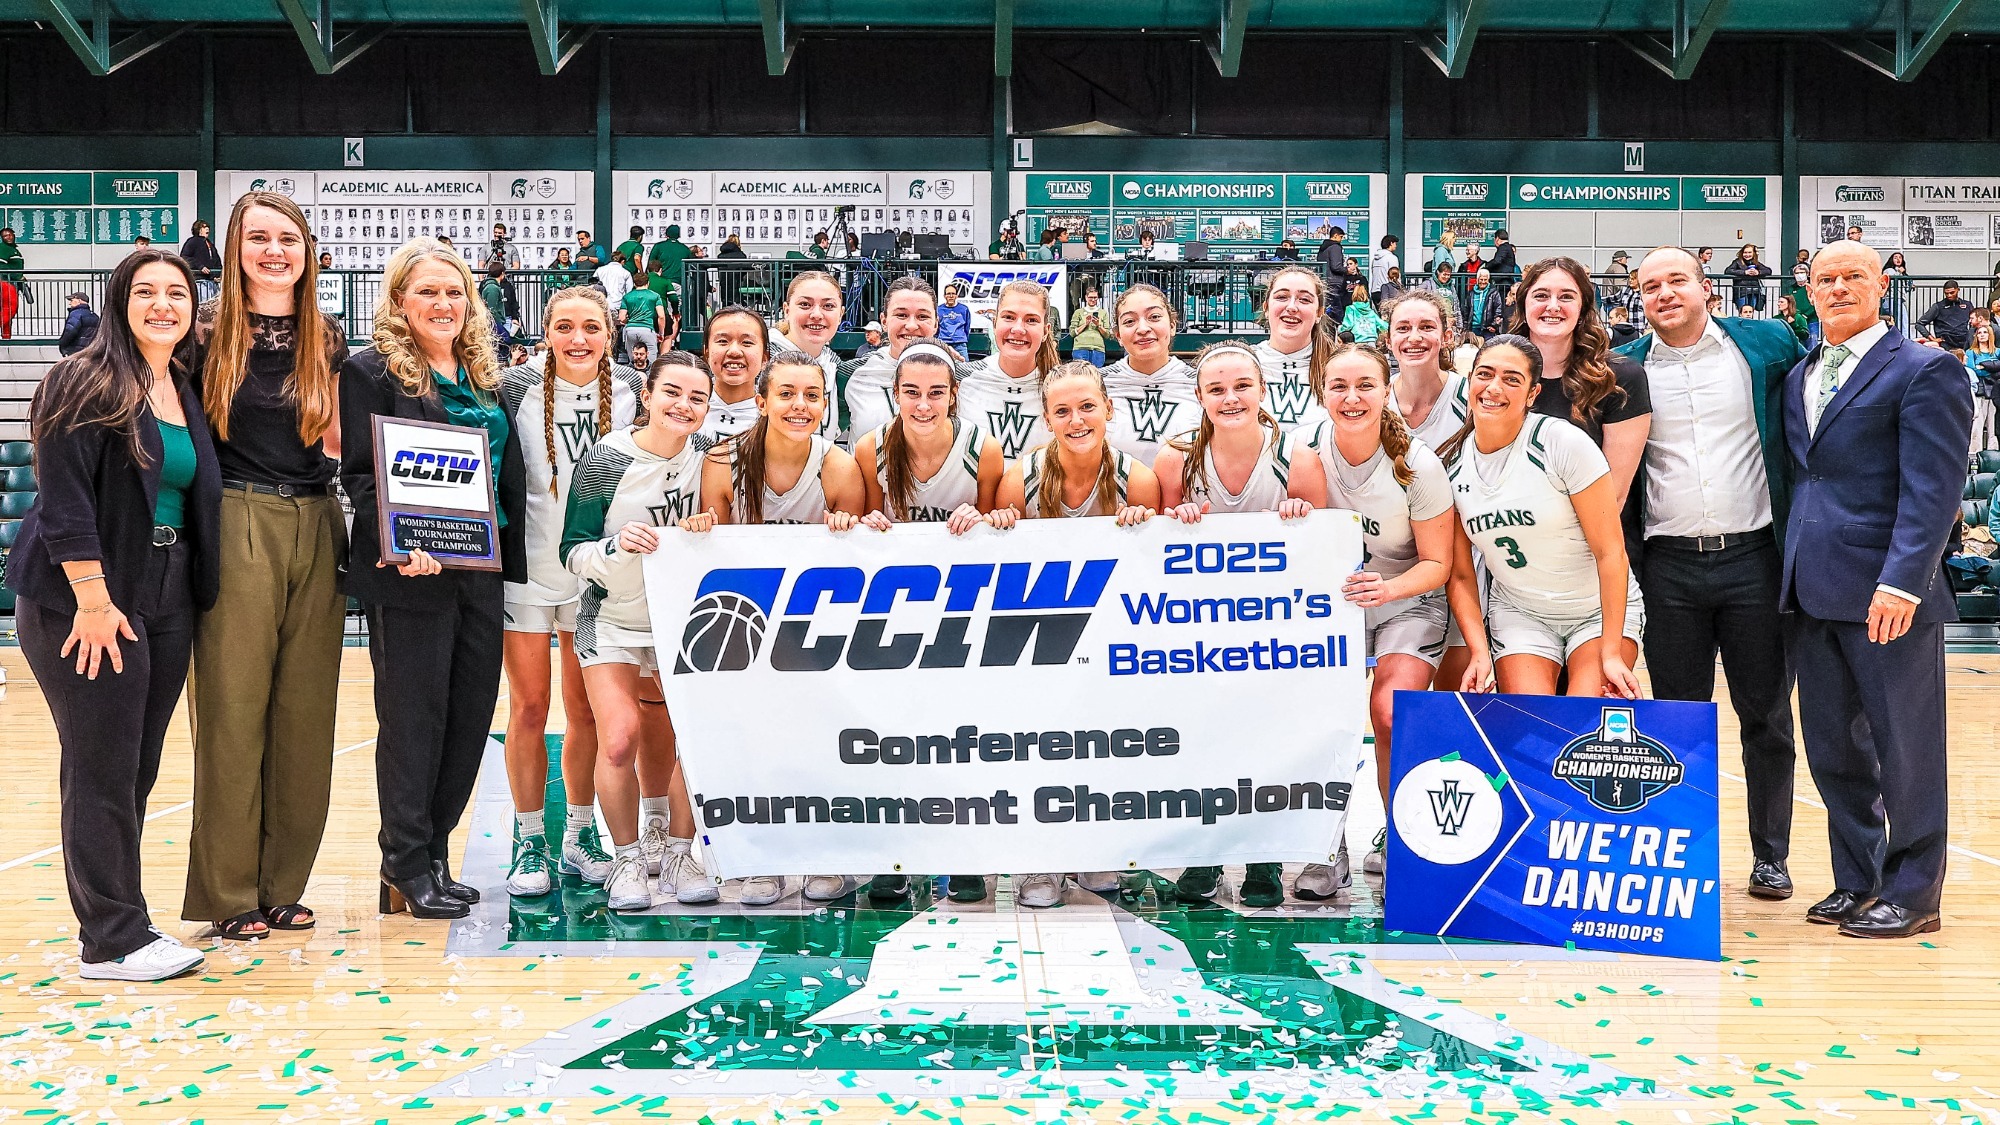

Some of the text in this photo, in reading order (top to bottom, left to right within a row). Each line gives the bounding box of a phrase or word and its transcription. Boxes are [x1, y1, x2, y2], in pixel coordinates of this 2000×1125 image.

[347, 142, 362, 161] K
[1018, 143, 1030, 162] L
[1626, 146, 1642, 166] M
[17, 183, 63, 195] TITANS
[116, 180, 158, 192] TITANS
[322, 182, 484, 193] ACADEMIC ALL-AMERICA
[720, 182, 882, 194] ACADEMIC ALL-AMERICA
[1049, 182, 1091, 193] TITANS
[1143, 183, 1275, 198] CHAMPIONSHIPS
[1309, 183, 1351, 195] TITANS
[1445, 184, 1487, 195] TITANS
[1540, 186, 1671, 200] CHAMPIONSHIPS
[1705, 186, 1747, 197] TITANS
[1909, 185, 2000, 199] TITAN TRAI
[1848, 191, 1884, 201] TITANS
[391, 450, 481, 484] CCIW
[399, 517, 485, 532] WOMEN'S BASKETBALL
[1466, 508, 1536, 535] TITANS
[412, 528, 472, 541] TOURNAMENT
[404, 538, 422, 548] 2025
[431, 540, 482, 552] CHAMPIONS
[1494, 535, 1528, 570] 3
[1164, 541, 1287, 574] 2025
[1120, 588, 1332, 625] Women's
[770, 558, 1118, 671] CCIW
[1109, 634, 1348, 676] Basketball
[838, 725, 1180, 765] Conference
[1585, 744, 1650, 755] 2025 DIII
[1572, 752, 1664, 764] WOMEN'S BASKETBALL
[1557, 760, 1679, 781] CHAMPIONSHIP
[694, 778, 1352, 828] ournament Champions
[1548, 820, 1692, 869] WE'RE
[1522, 866, 1716, 920] DANCIN'
[1571, 921, 1664, 943] #D3HOOPS
